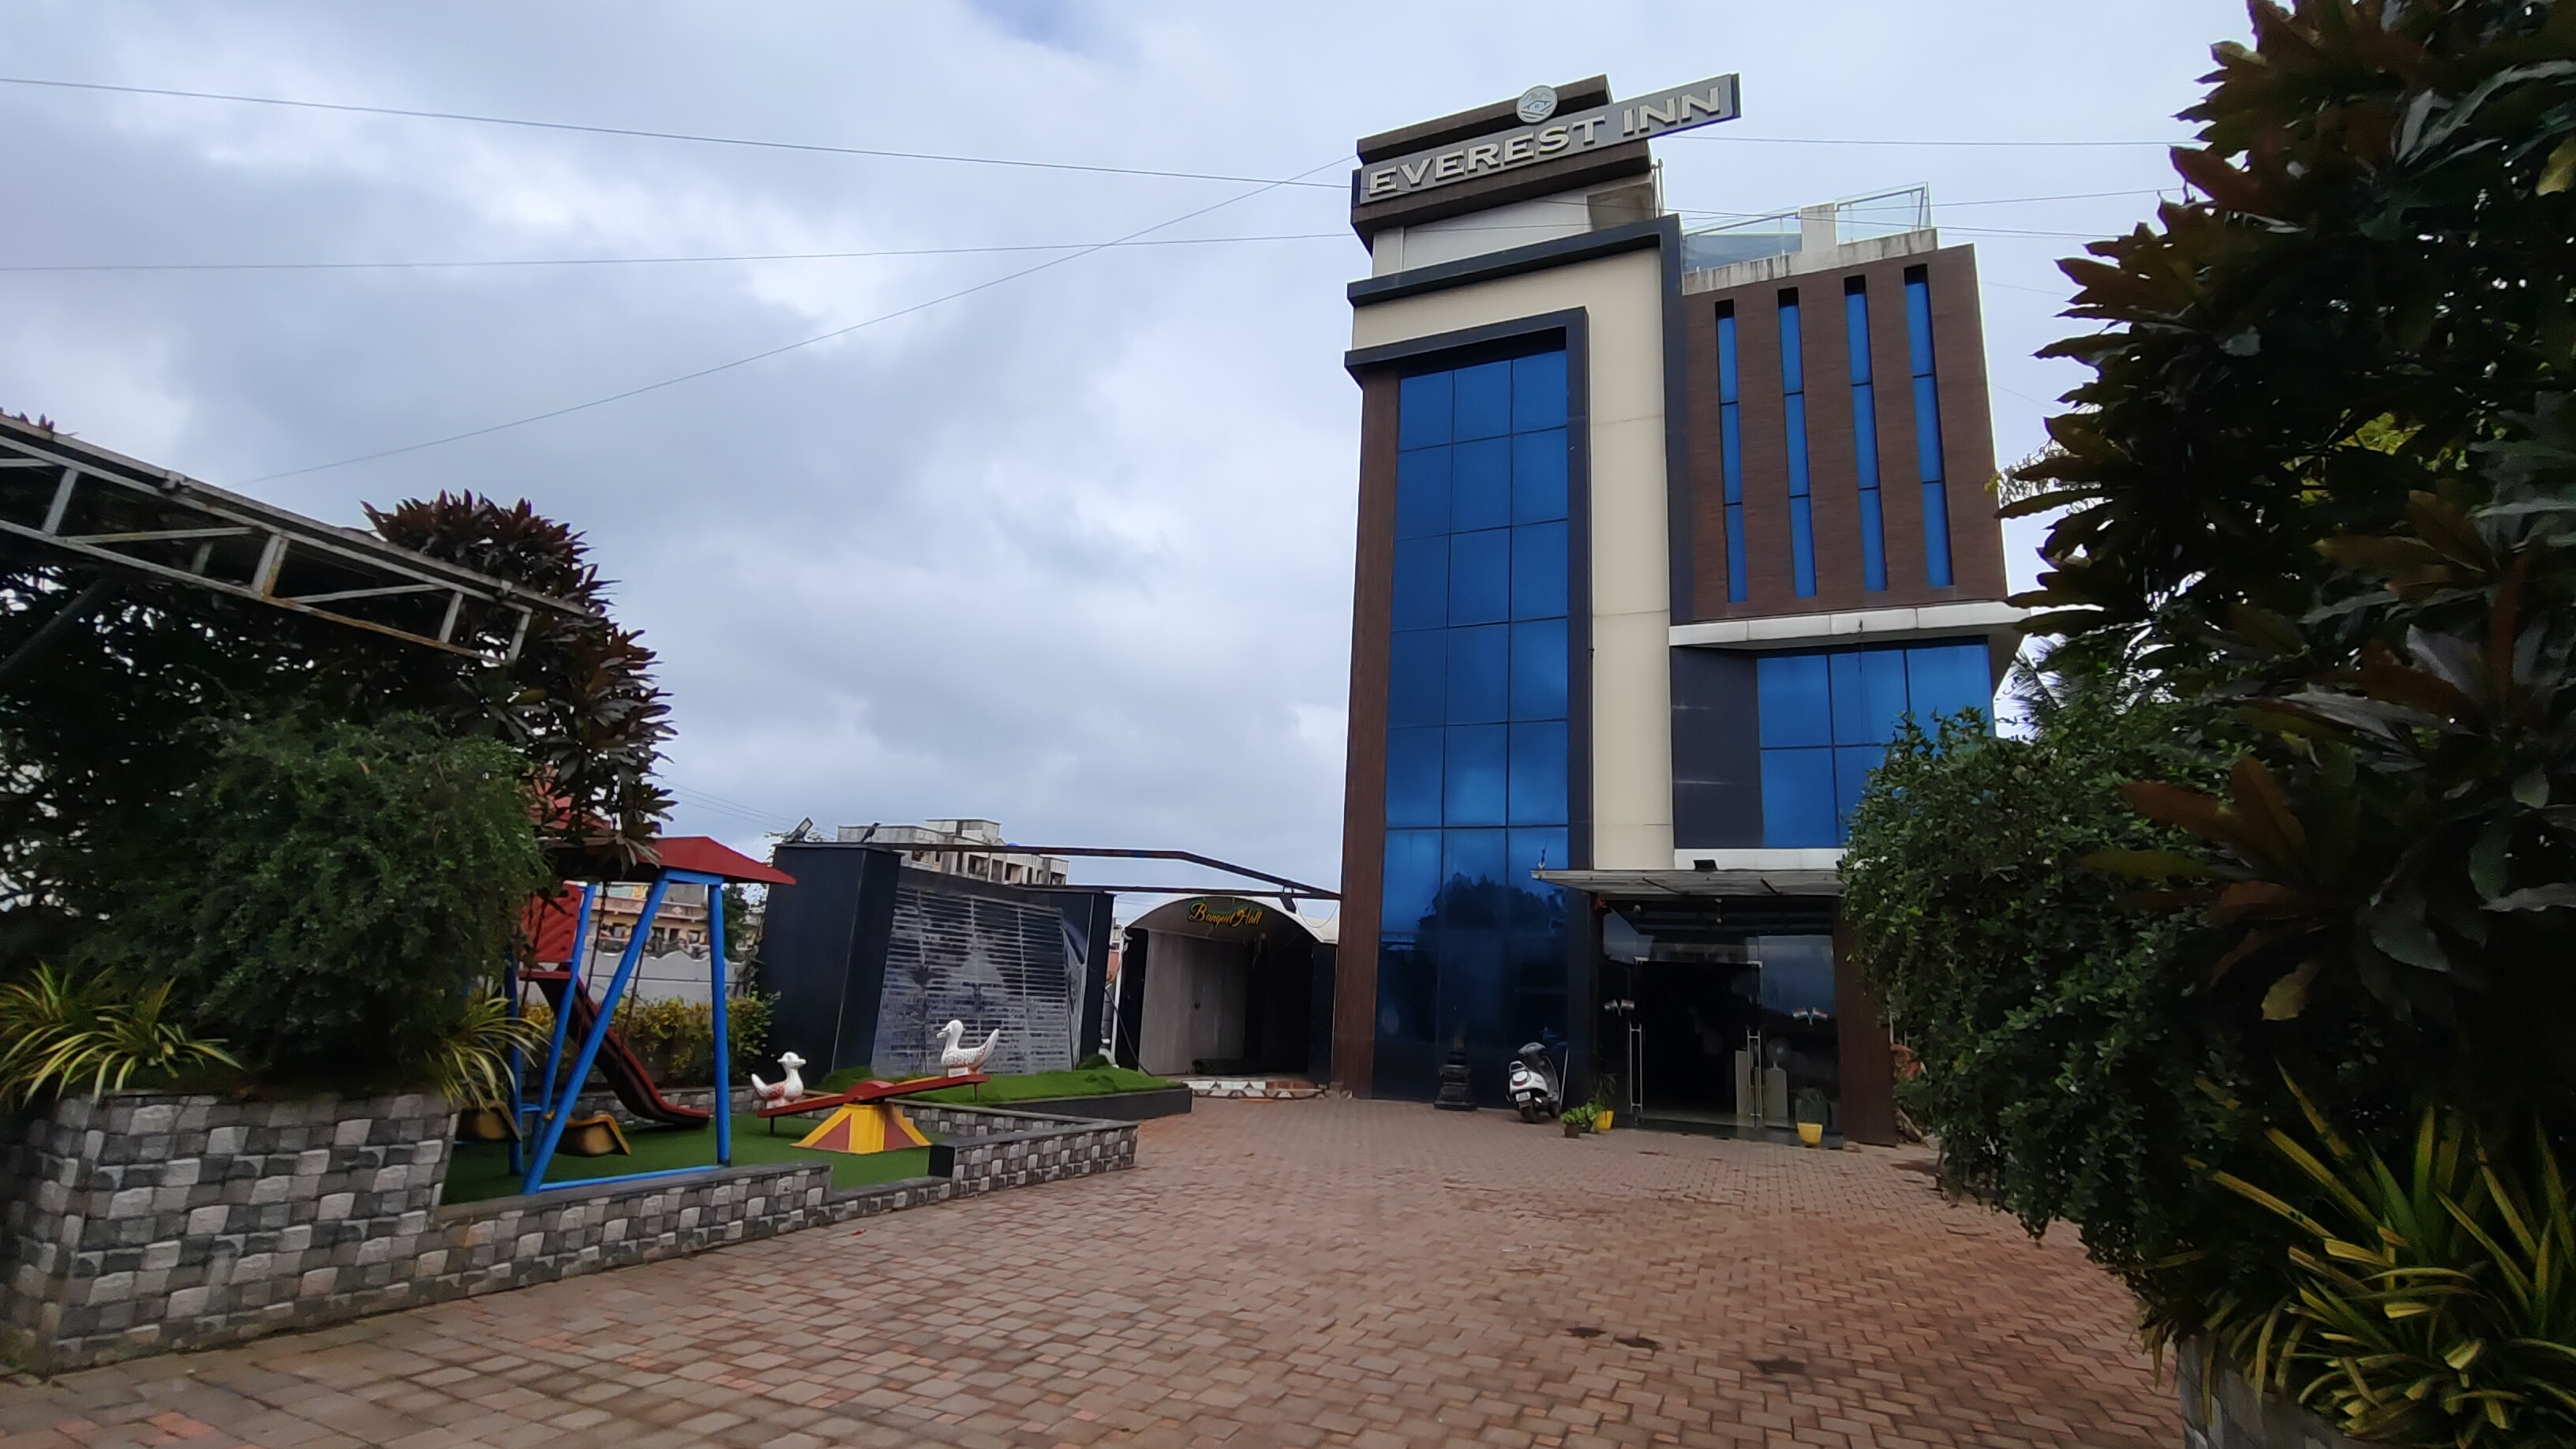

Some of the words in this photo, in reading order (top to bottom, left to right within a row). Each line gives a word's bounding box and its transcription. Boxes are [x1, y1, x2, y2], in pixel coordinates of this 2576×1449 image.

[1368, 115, 1606, 195] EVEREST
[1623, 87, 1720, 136] INN
[1231, 906, 1264, 927] Hall
